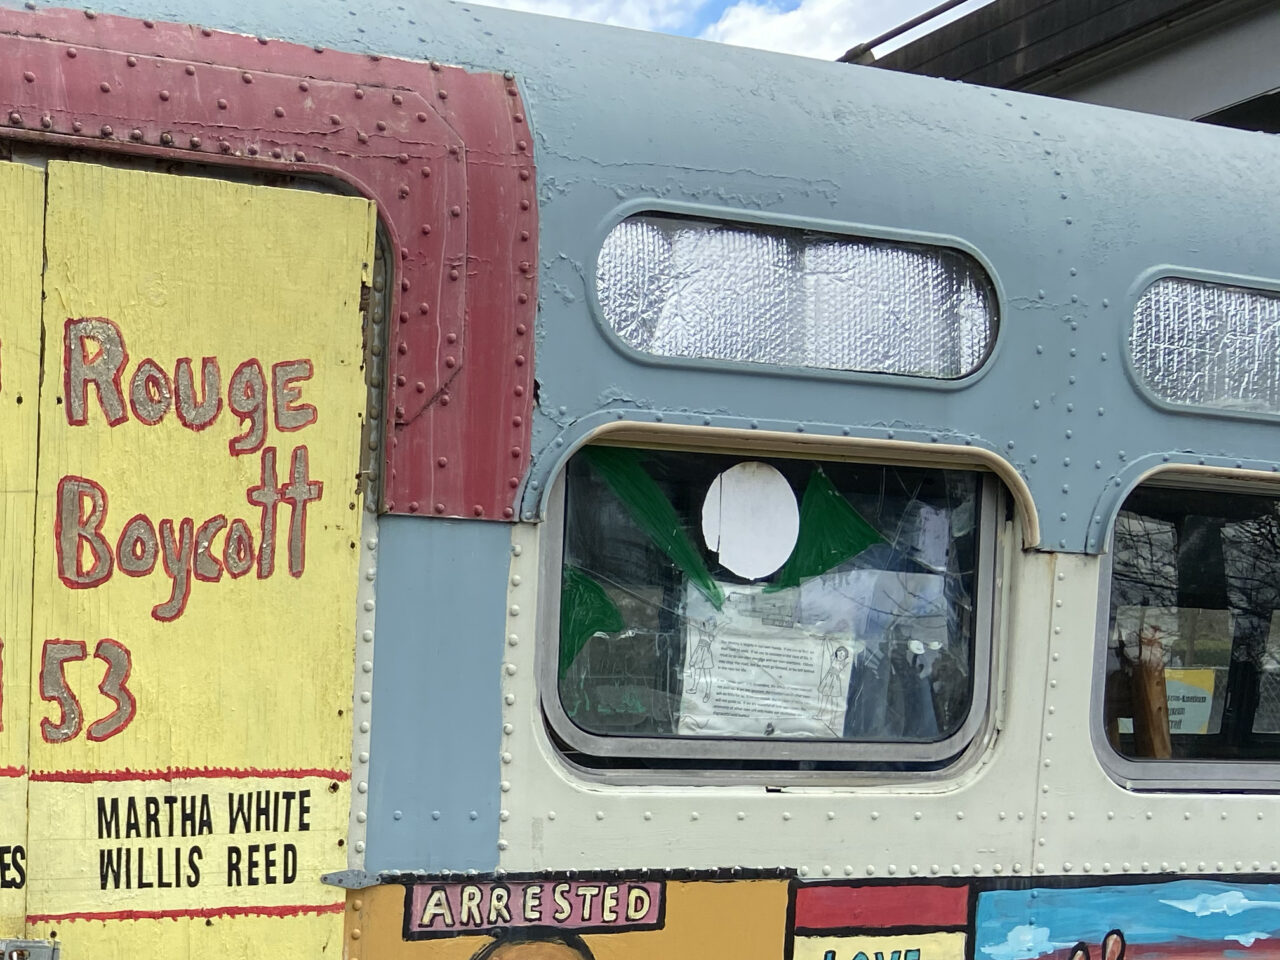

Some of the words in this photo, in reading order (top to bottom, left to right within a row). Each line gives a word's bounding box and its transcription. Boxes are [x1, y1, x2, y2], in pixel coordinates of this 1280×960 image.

[98, 794, 212, 839] MARTHA
[229, 790, 311, 834] WHITE
[100, 846, 202, 890] WILLIS
[228, 844, 297, 887] REED
[421, 882, 652, 927] ARRESTED
